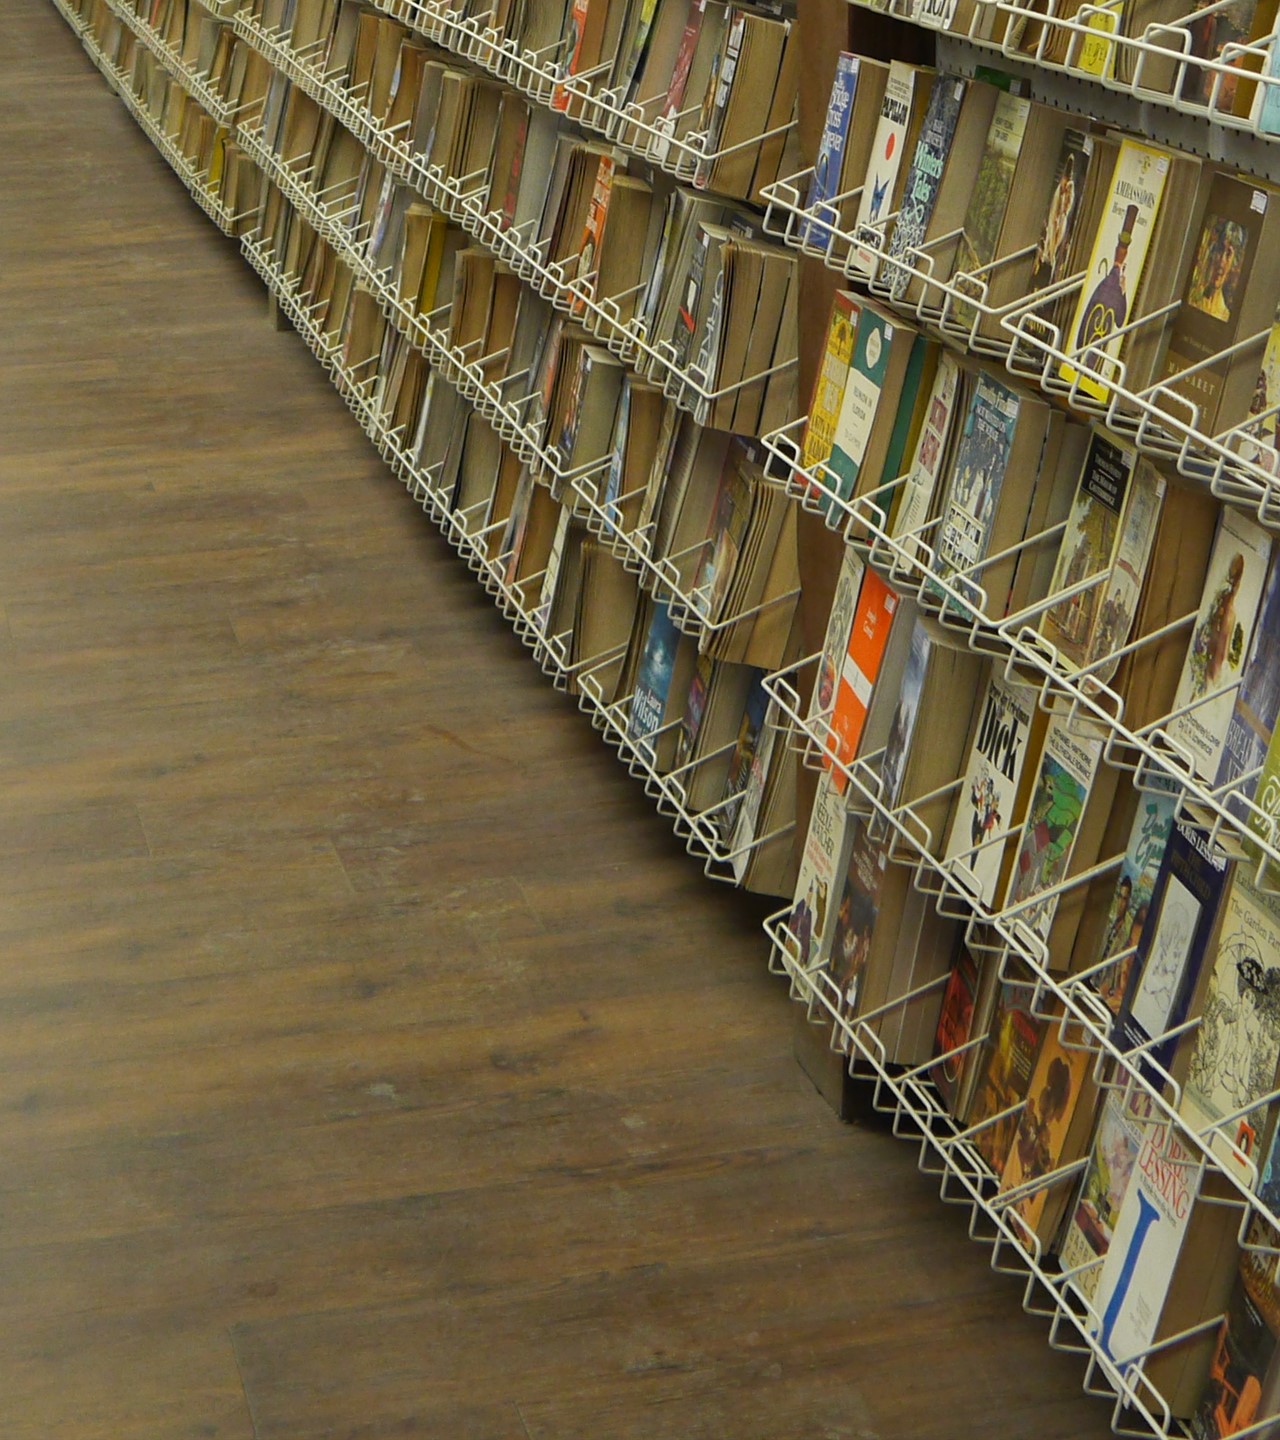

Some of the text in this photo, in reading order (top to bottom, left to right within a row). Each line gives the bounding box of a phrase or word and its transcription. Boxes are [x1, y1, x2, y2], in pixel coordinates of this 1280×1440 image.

[1230, 896, 1243, 915] The
[1242, 908, 1268, 942] Garden
[1140, 1141, 1192, 1220] LESSING
